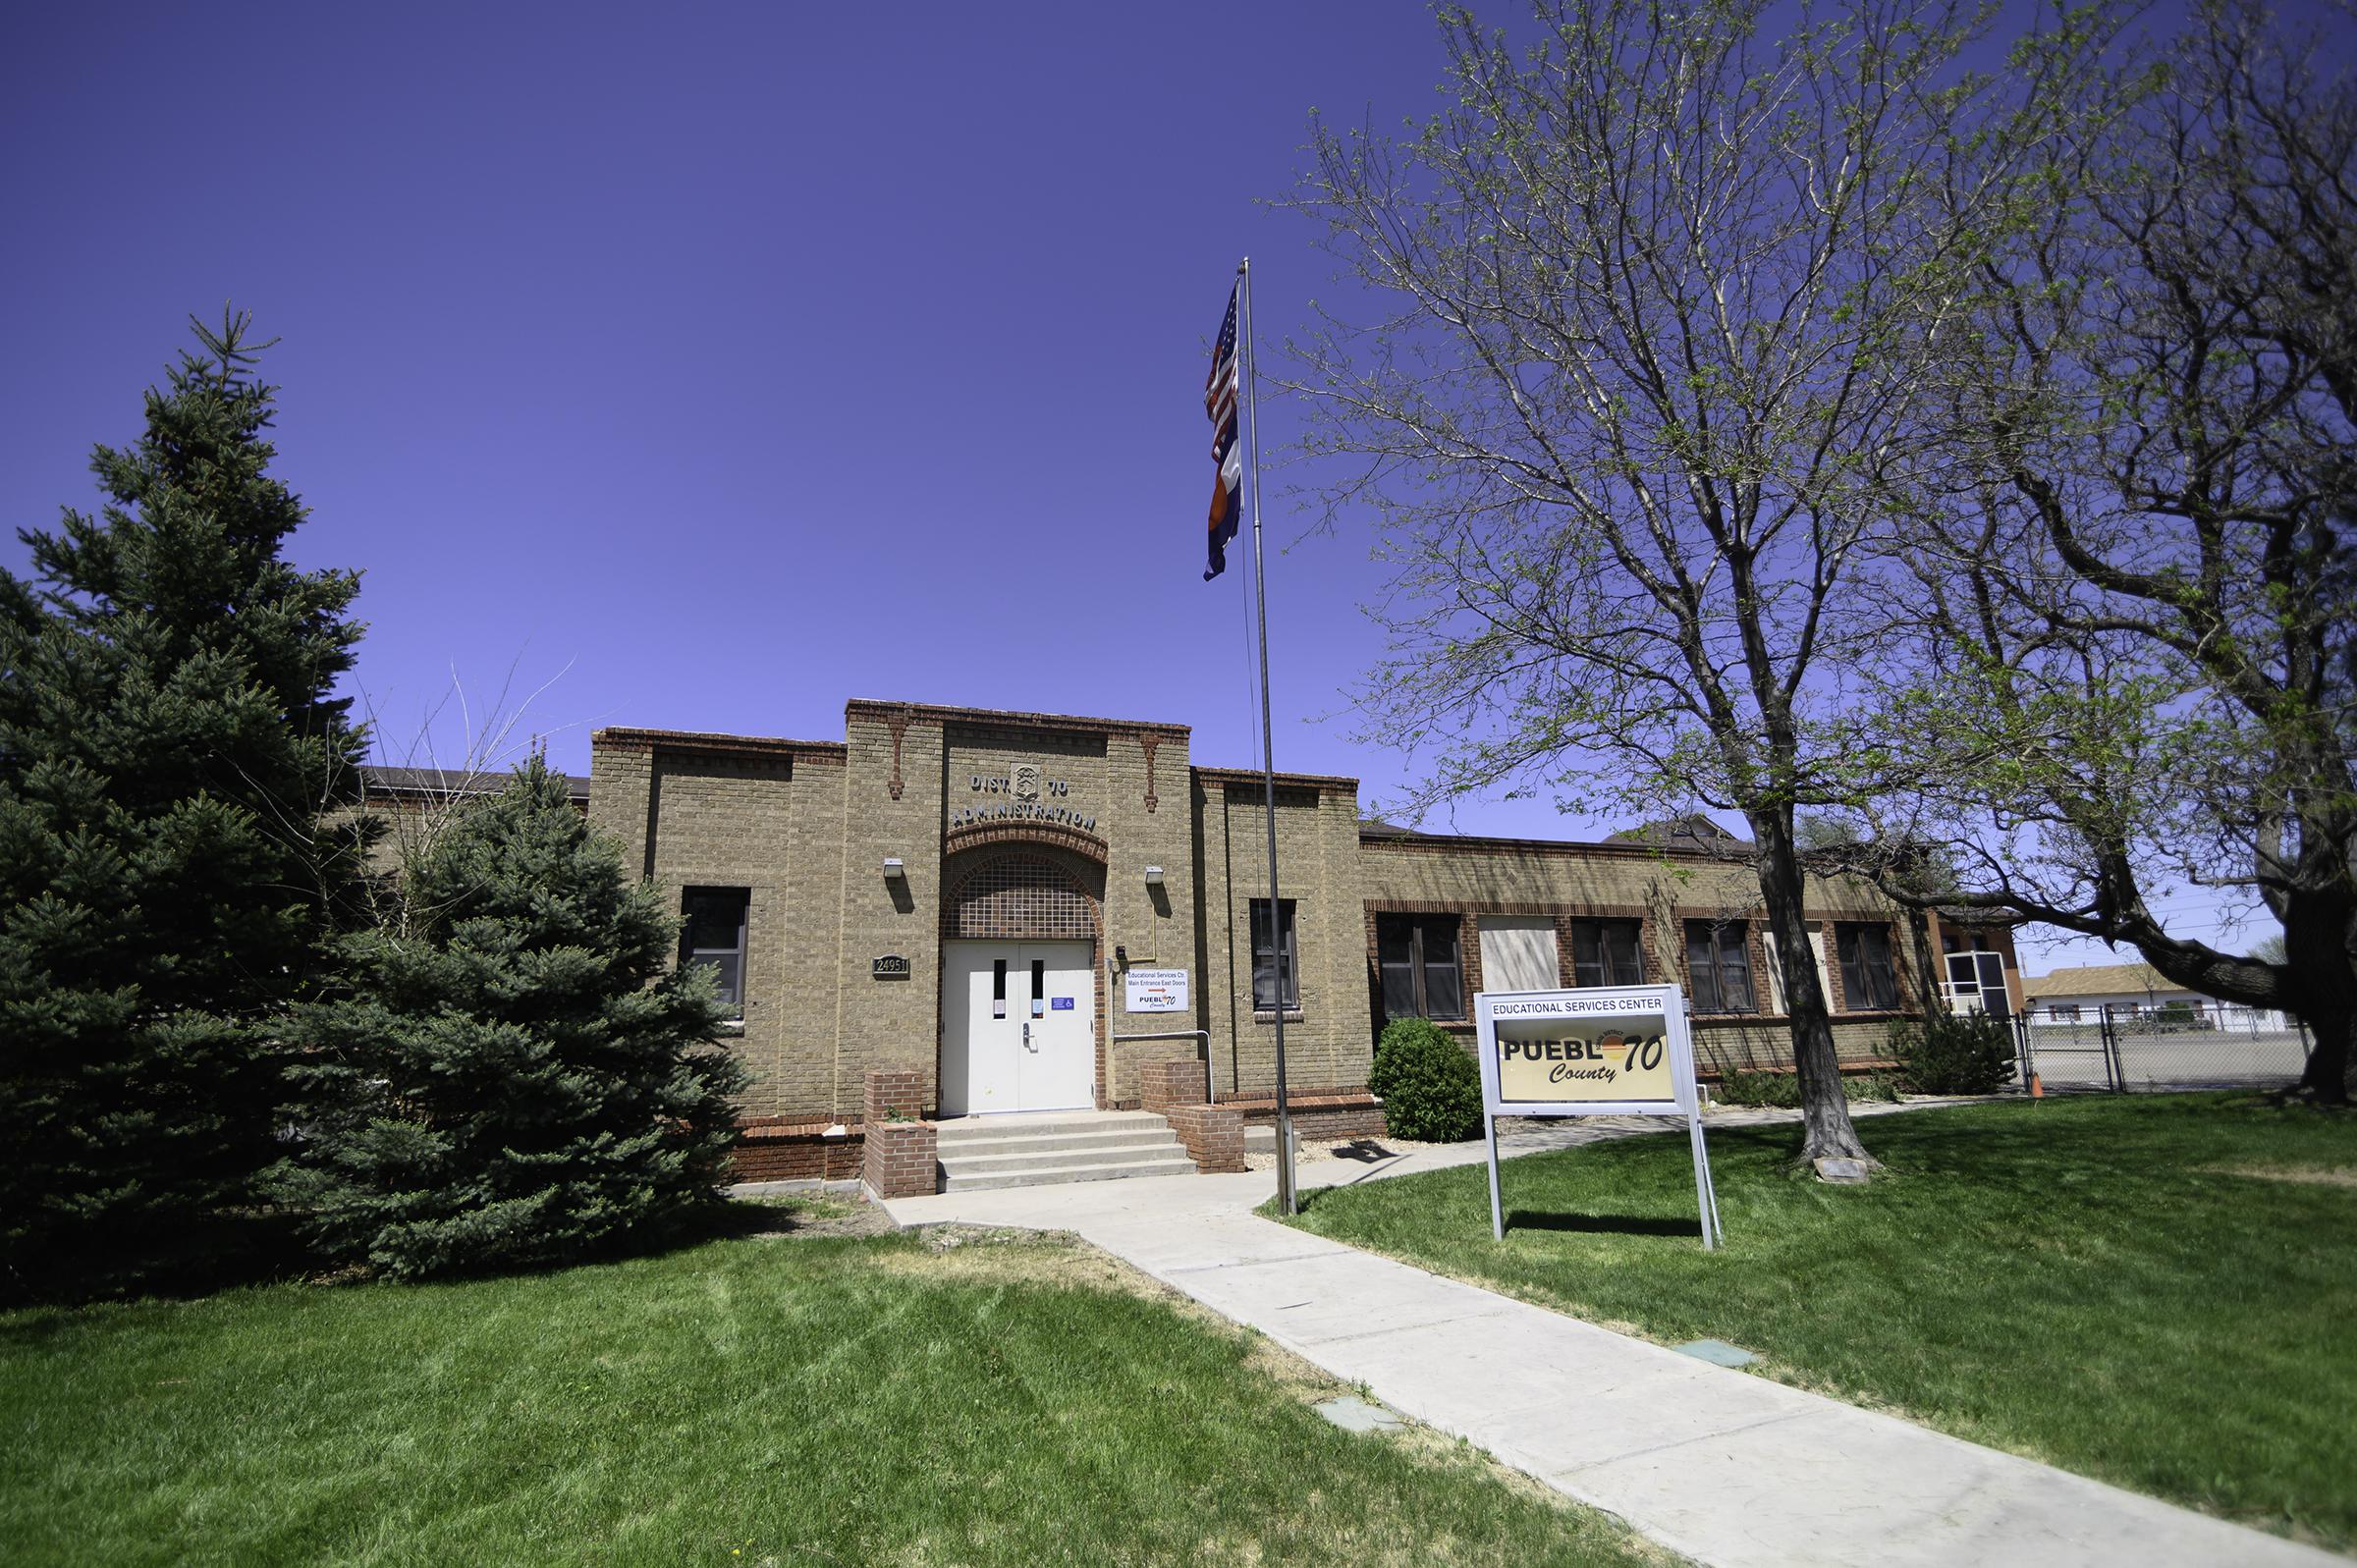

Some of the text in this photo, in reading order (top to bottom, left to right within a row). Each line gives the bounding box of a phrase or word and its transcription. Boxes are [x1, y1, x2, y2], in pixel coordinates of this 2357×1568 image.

[1048, 780, 1068, 796] 70
[953, 803, 1096, 831] ADMINISTRATION
[877, 959, 905, 971] 24951
[1166, 996, 1177, 1004] 70
[1493, 998, 1662, 1014] EDUCATIONAL SERVICES CENTER
[1621, 1035, 1663, 1072] 70
[1549, 1062, 1617, 1084] County
